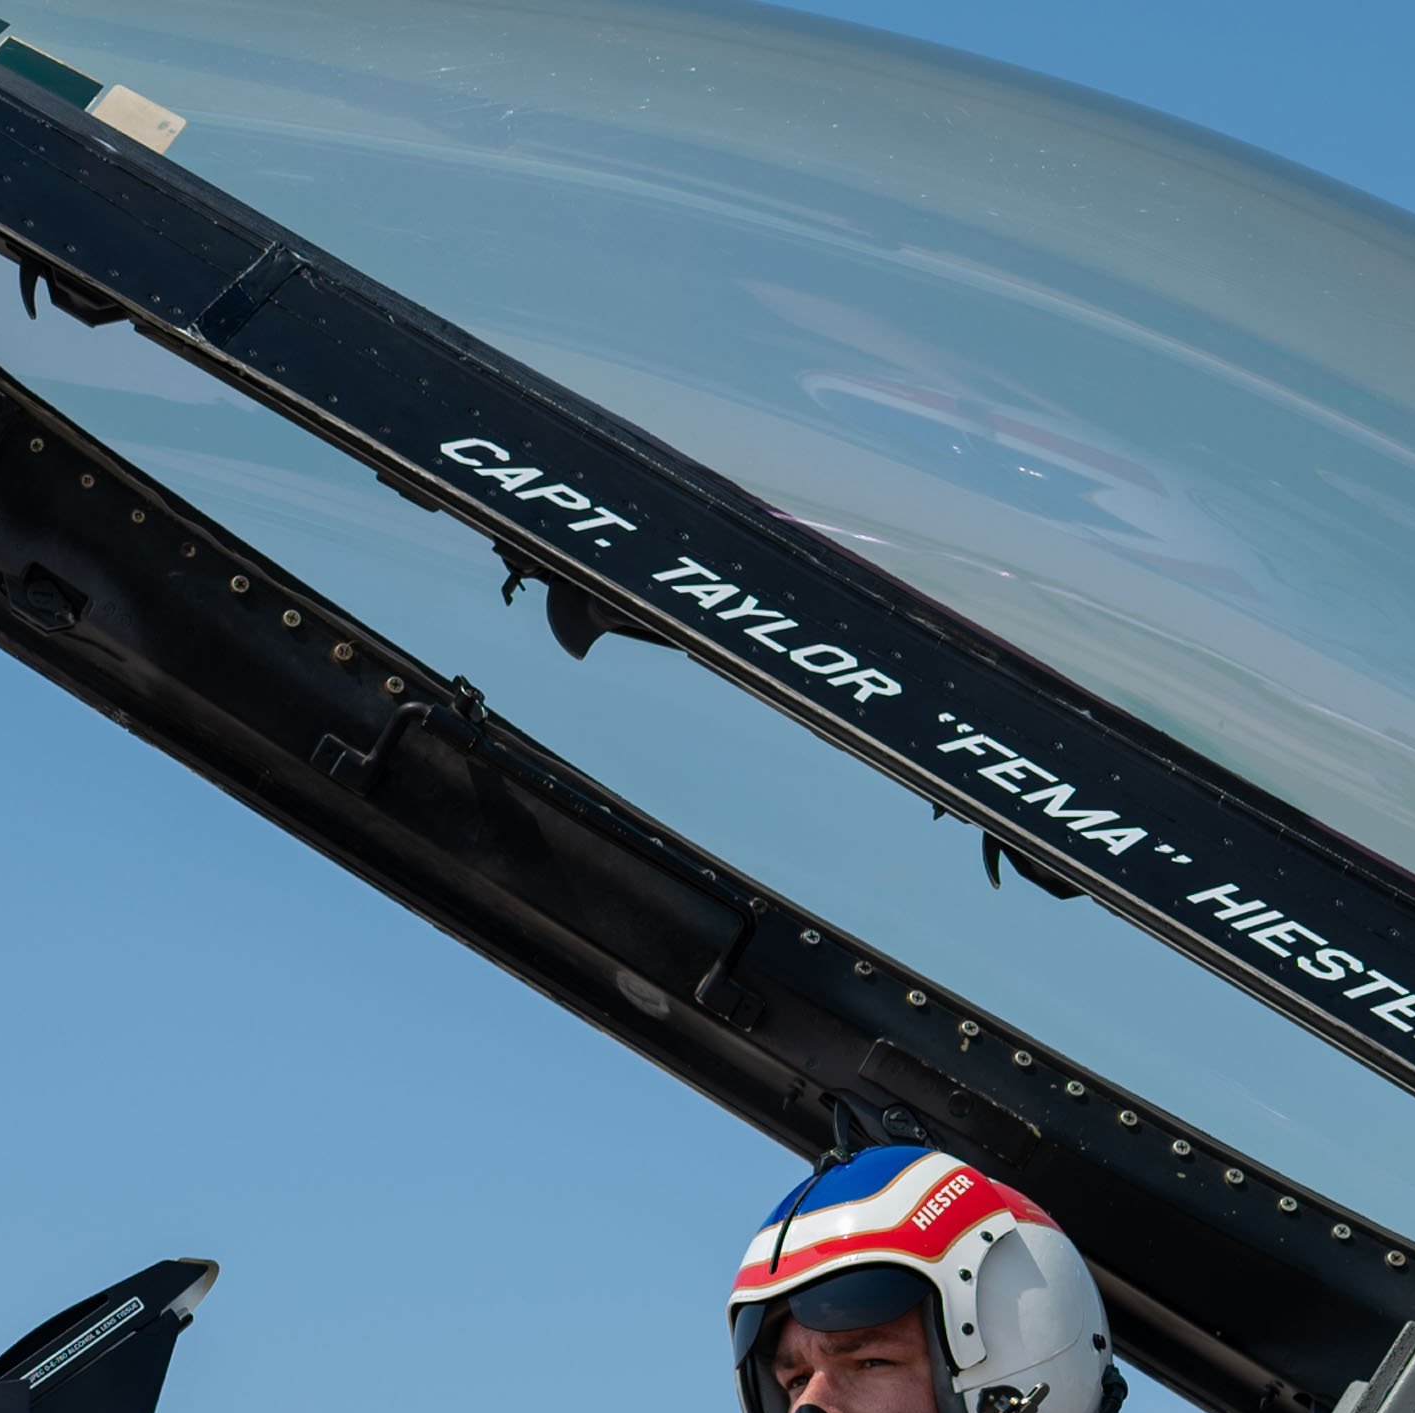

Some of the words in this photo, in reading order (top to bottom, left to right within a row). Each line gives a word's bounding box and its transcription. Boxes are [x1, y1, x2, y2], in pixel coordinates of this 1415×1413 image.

[439, 439, 636, 547] CAPT.
[653, 557, 901, 702] TAYLOR
[912, 1174, 974, 1231] HIESTER
[67, 1334, 95, 1356] ALCOHOL
[100, 1317, 117, 1331] LENS
[116, 1301, 139, 1320] TISSUE
